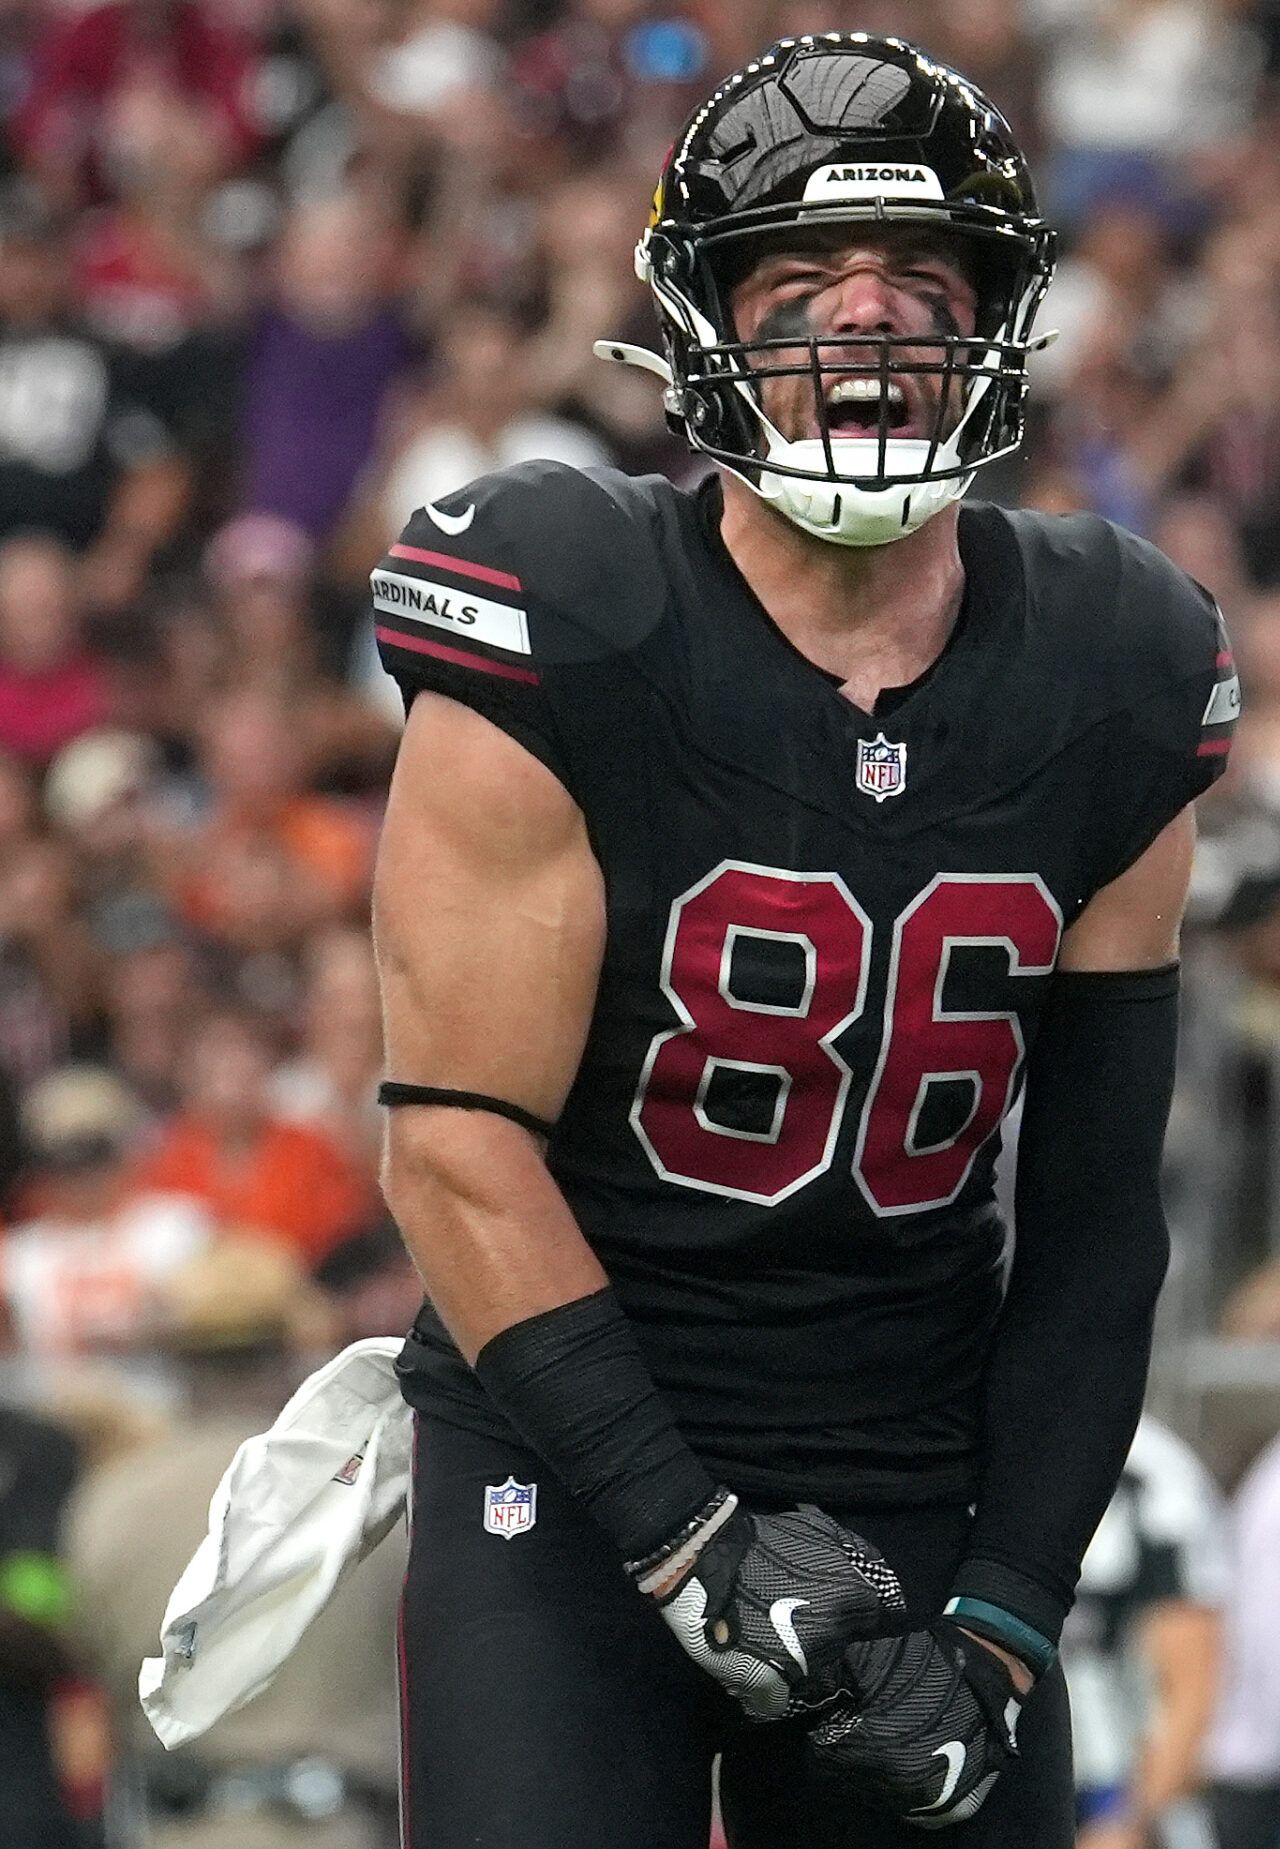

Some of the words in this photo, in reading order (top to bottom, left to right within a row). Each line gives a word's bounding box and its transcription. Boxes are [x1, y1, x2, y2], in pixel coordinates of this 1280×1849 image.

[827, 168, 926, 182] ARIZONA
[374, 581, 478, 625] ARDINALS
[865, 764, 896, 789] NFL
[628, 858, 1065, 1217] 86
[494, 1505, 526, 1527] NFL
